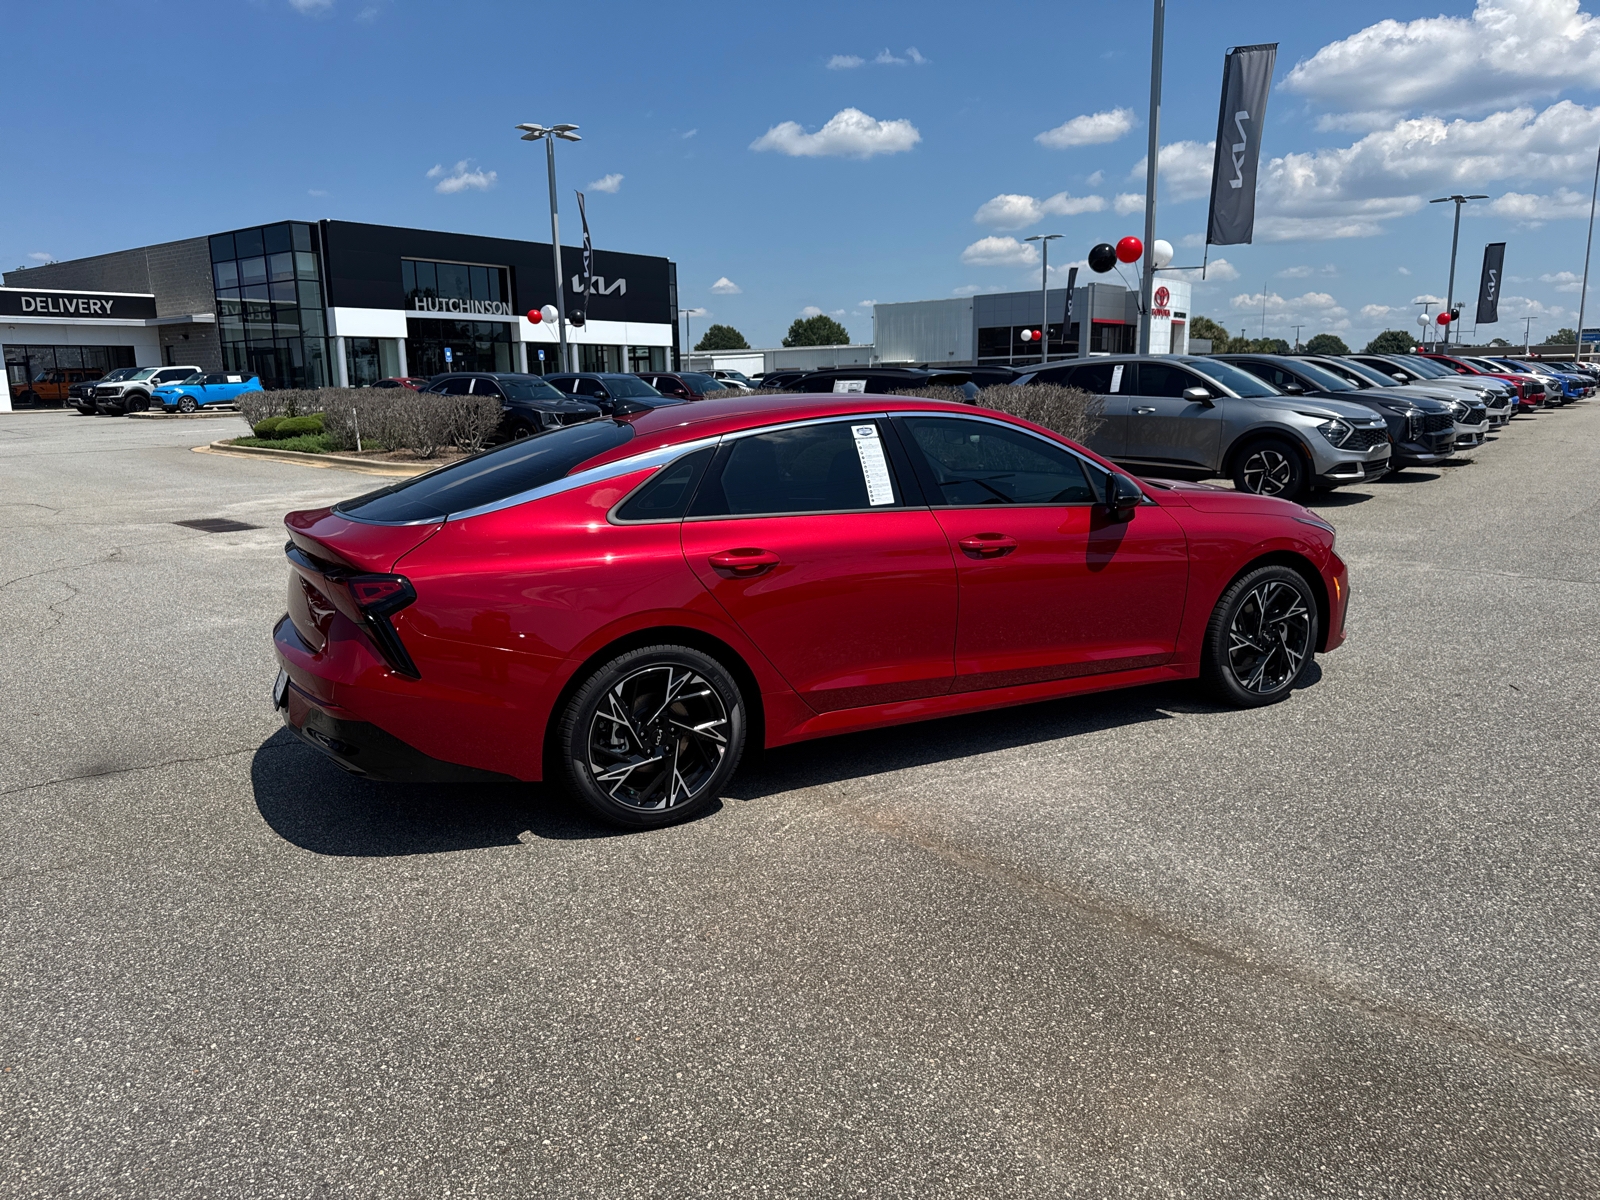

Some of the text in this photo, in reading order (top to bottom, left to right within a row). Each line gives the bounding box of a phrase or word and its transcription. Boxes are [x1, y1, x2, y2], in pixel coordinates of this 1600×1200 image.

[1228, 110, 1250, 189] KIA
[571, 274, 627, 297] KIA
[21, 296, 114, 314] DELIVERY
[414, 297, 512, 316] HUTCHINSON
